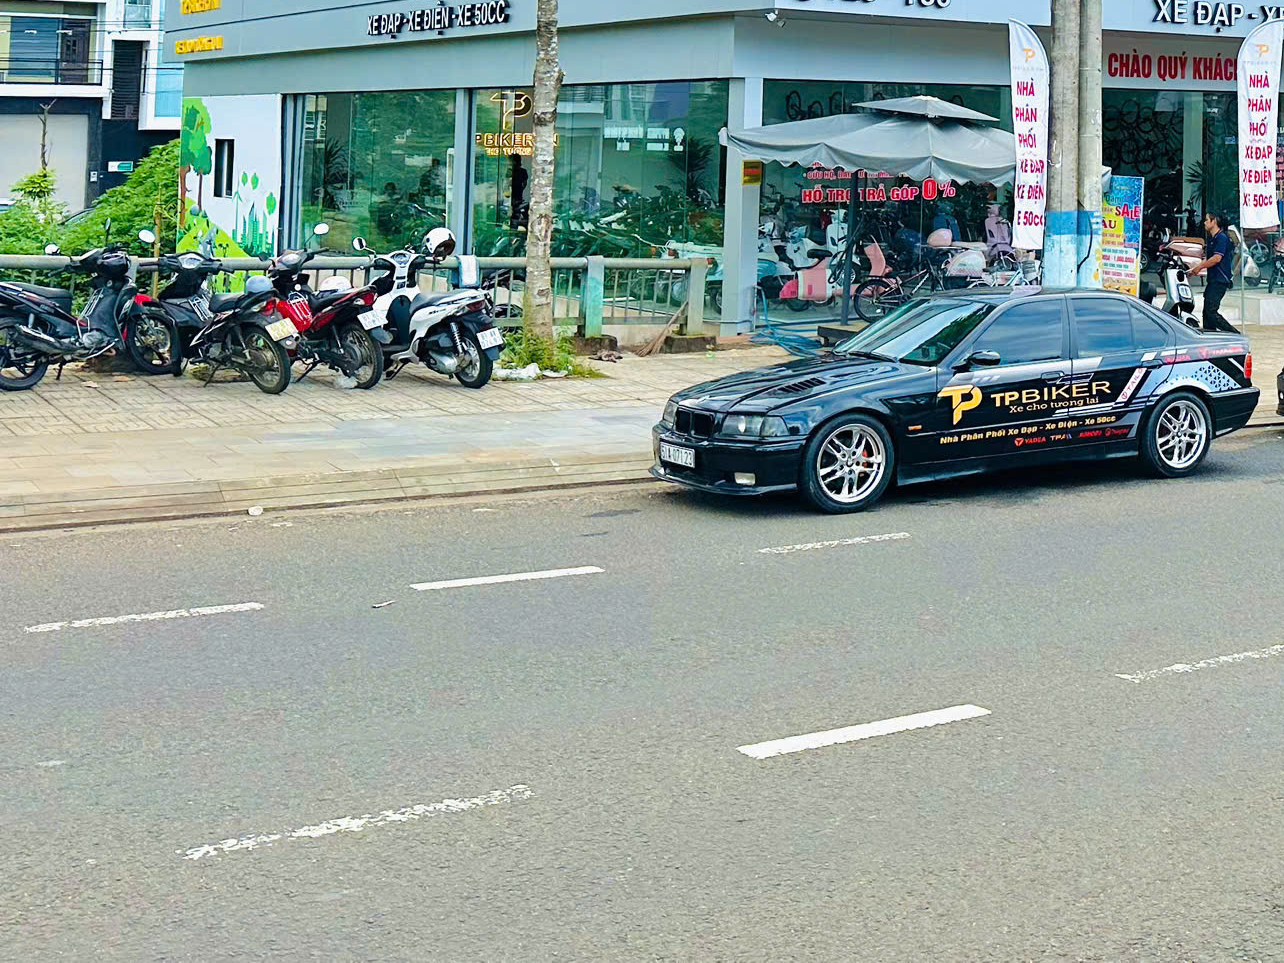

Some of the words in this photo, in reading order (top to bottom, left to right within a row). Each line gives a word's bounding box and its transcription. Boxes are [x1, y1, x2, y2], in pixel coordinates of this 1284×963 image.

[367, 15, 379, 35] XE
[380, 13, 401, 39] ĐẠP
[407, 10, 421, 31] XE
[423, 0, 450, 36] ĐIỆN
[456, 4, 472, 27] XE
[474, 0, 507, 24] 50CC
[1195, 0, 1244, 33] ĐẠP
[1107, 48, 1151, 79] CHÀO
[1157, 51, 1187, 81] QUÝ
[1016, 77, 1035, 96] NHÀ
[1249, 71, 1269, 88] NHÀ
[1015, 103, 1037, 122] PHÂN
[1018, 127, 1036, 148] PHỐI
[1243, 169, 1252, 183] XE
[802, 184, 823, 203] HỖ
[891, 184, 919, 200] GÓP
[1115, 203, 1140, 220] SALE
[990, 381, 1112, 407] TPBIKER
[1009, 405, 1024, 413] Xe
[1026, 403, 1047, 412] cho
[1050, 398, 1084, 409] tương
[1086, 396, 1099, 405] lai
[940, 435, 959, 444] Nhà
[961, 431, 984, 442] Phân
[985, 428, 1006, 439] Phối
[1007, 428, 1019, 436] Xe
[1045, 423, 1056, 431] Xe
[1085, 418, 1096, 426] Xe
